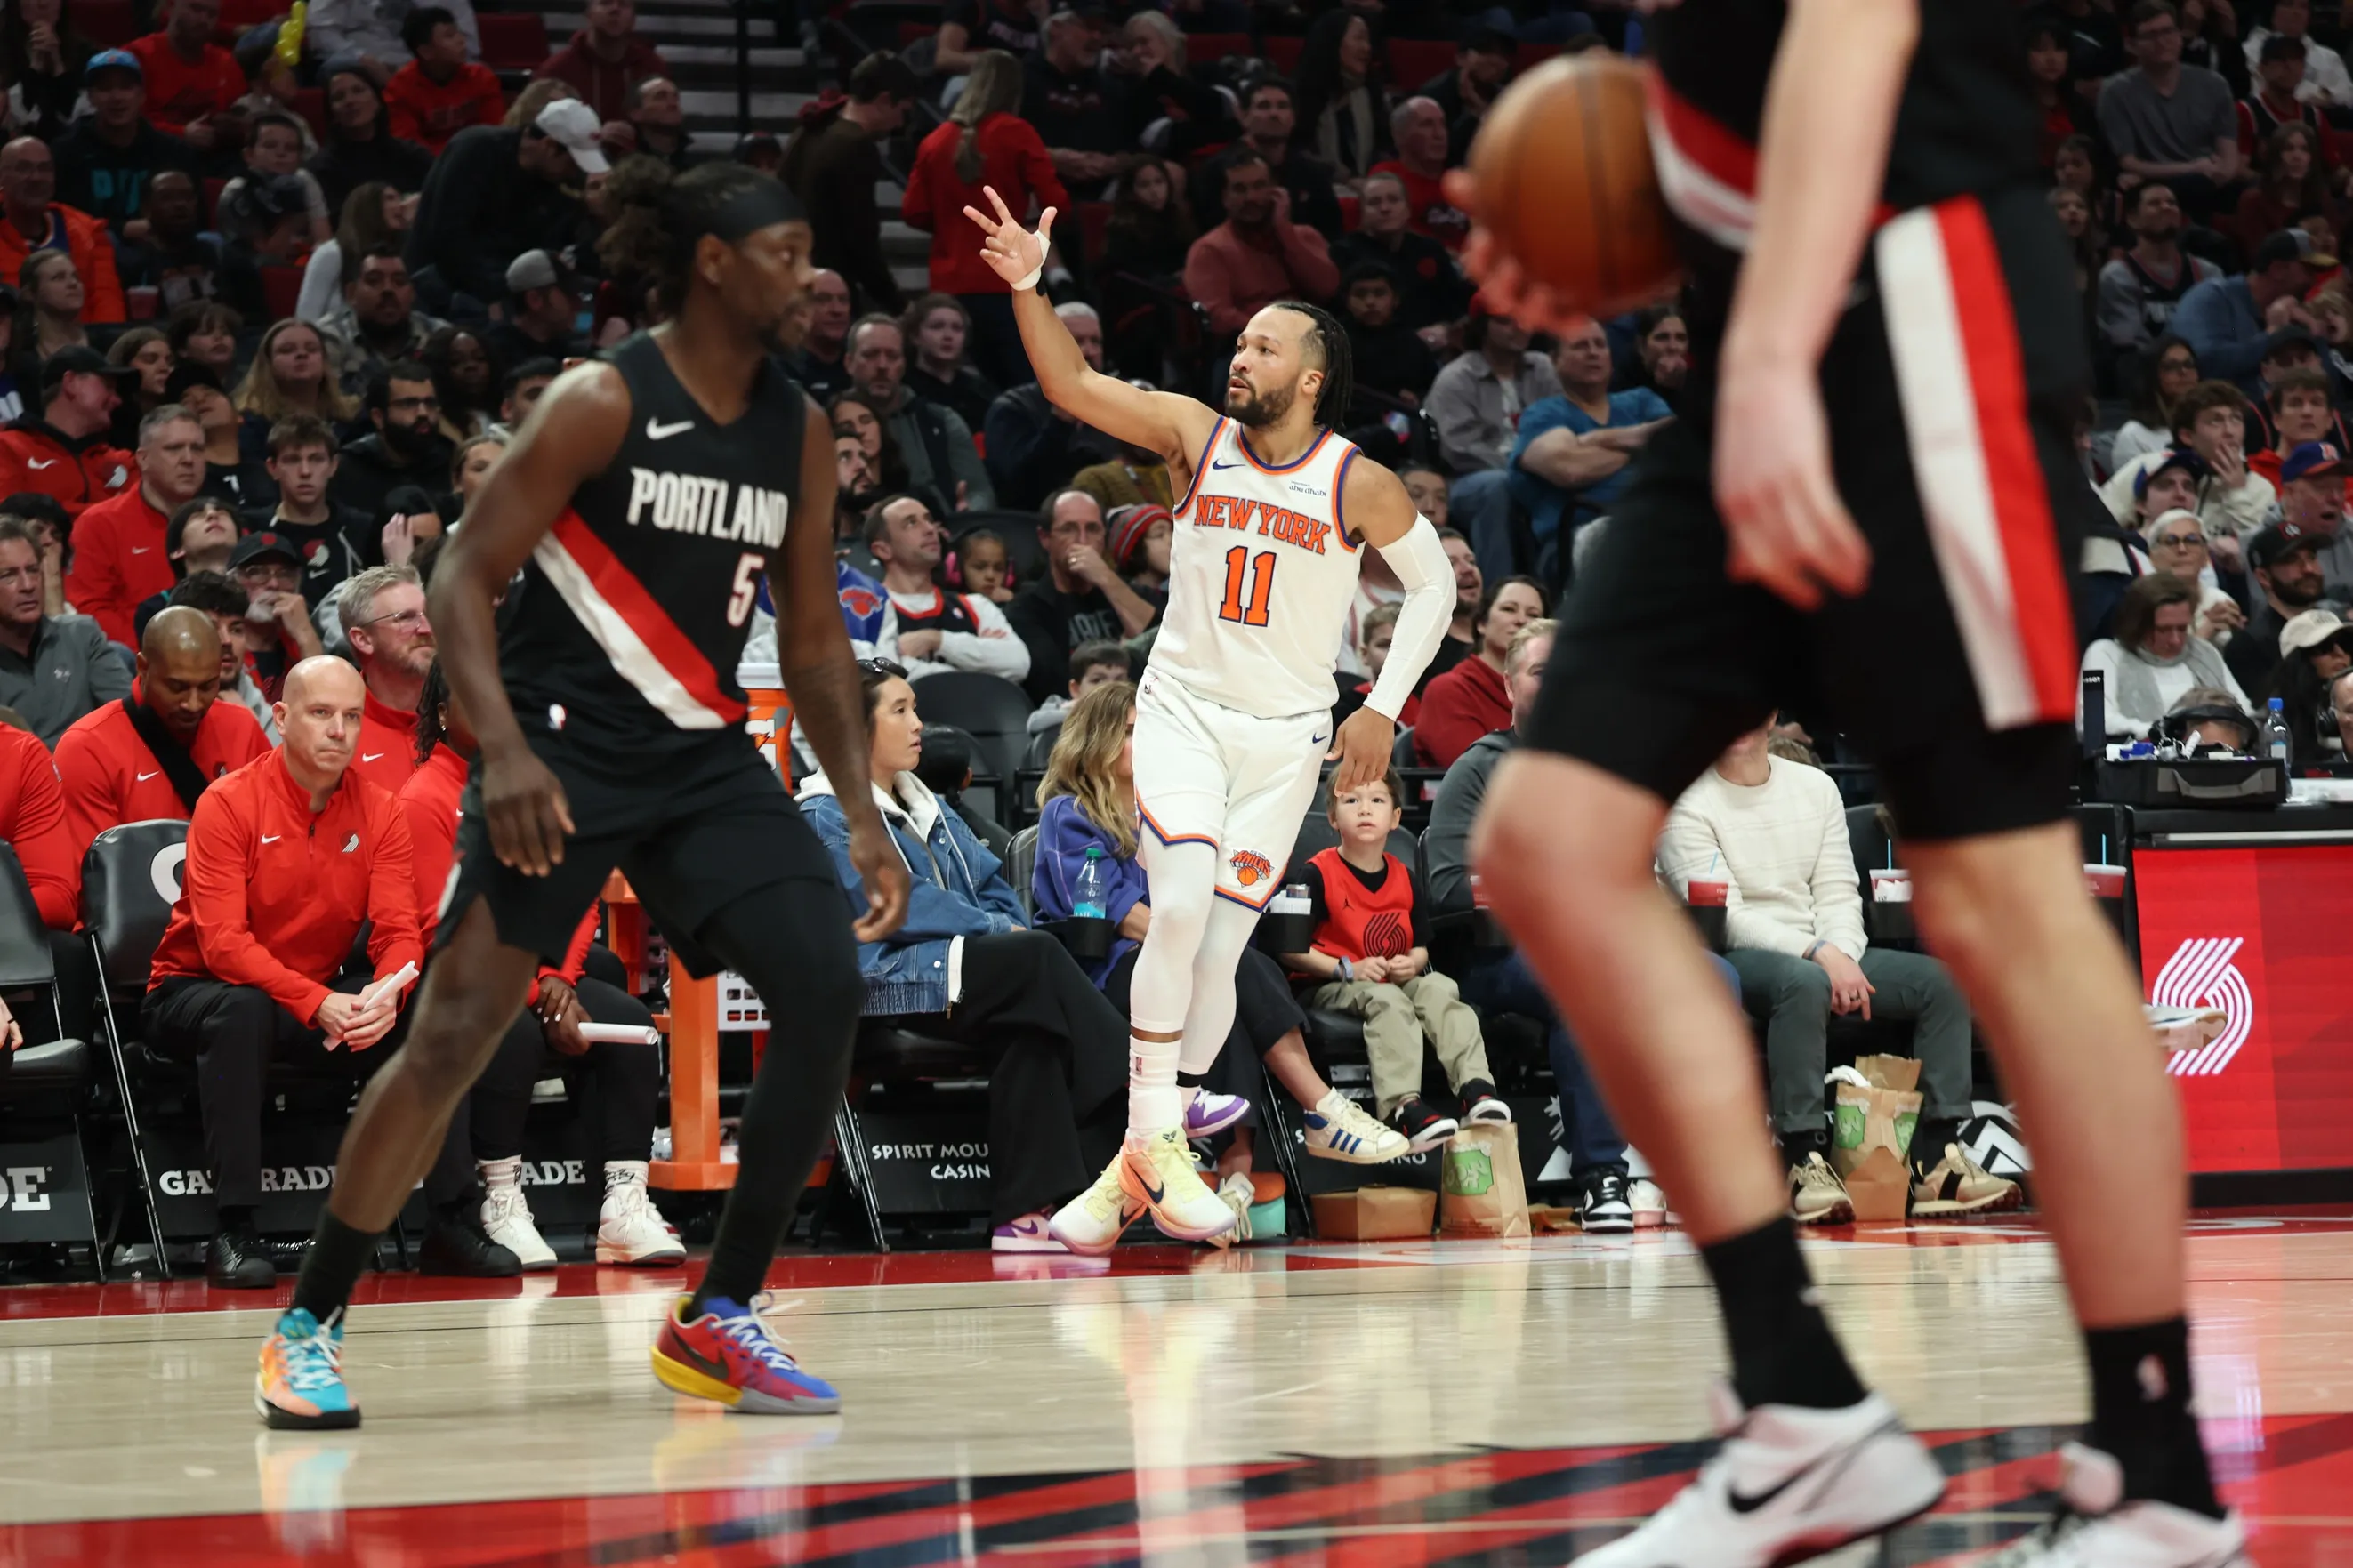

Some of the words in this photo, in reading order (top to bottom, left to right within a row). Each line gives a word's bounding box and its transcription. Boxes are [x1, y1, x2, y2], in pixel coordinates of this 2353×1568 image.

[626, 466, 789, 549] PORTLAND
[1194, 495, 1256, 530] NEW
[1257, 502, 1332, 556] YORK
[727, 552, 765, 627] 5
[1219, 545, 1277, 627] 11
[871, 1145, 934, 1160] SPIRIT
[940, 1143, 989, 1158] MOU
[931, 1163, 991, 1179] CASIN
